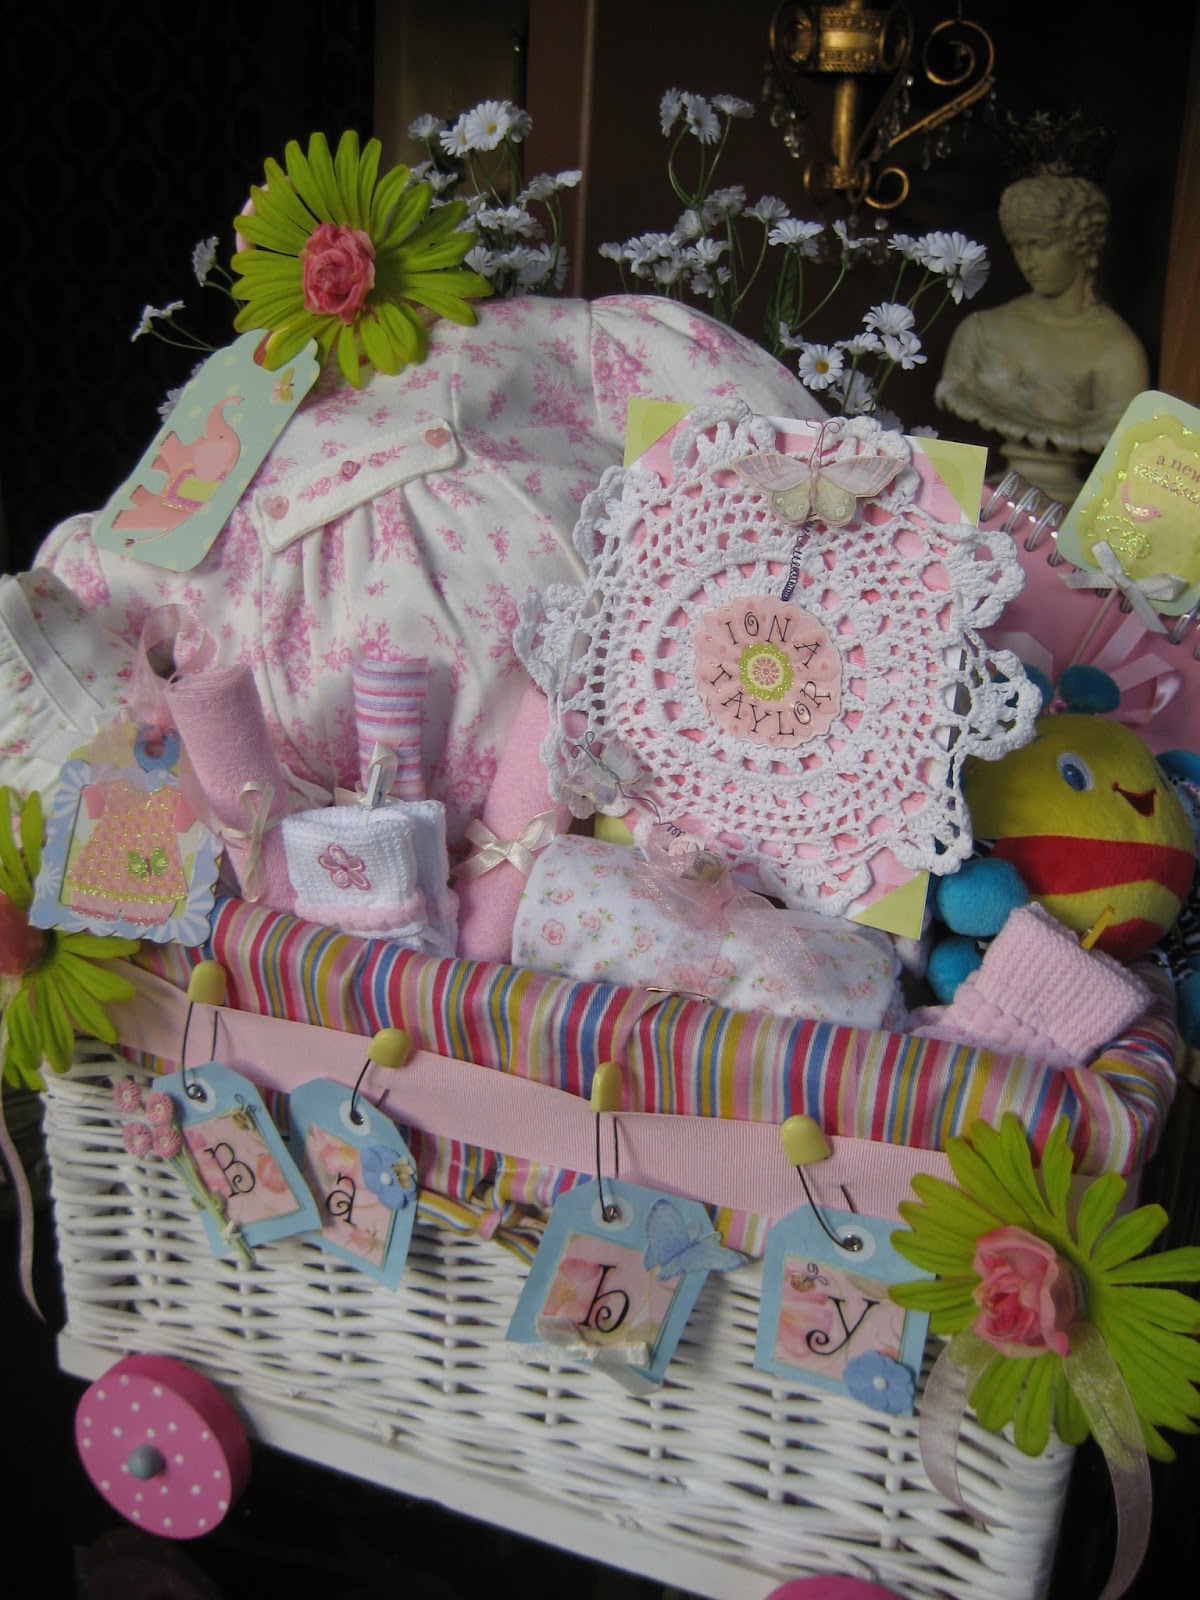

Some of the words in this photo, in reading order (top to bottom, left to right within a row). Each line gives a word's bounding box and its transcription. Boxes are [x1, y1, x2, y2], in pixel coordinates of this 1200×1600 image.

[1156, 455, 1165, 465] a
[725, 611, 821, 669] IONA
[710, 663, 831, 737] TAYLOR
